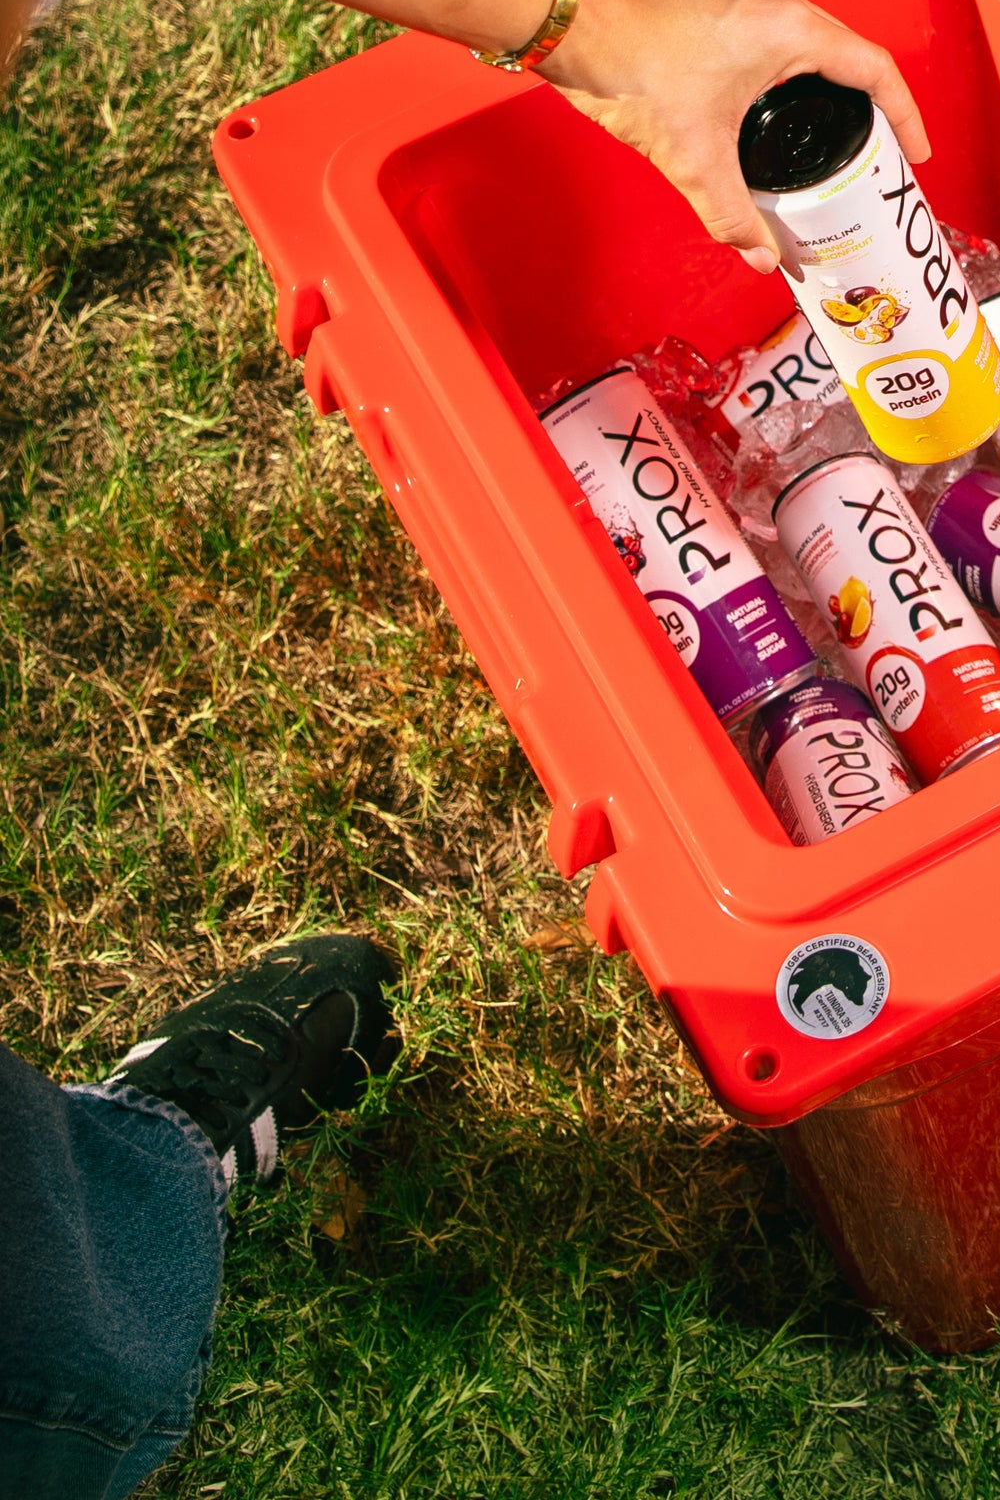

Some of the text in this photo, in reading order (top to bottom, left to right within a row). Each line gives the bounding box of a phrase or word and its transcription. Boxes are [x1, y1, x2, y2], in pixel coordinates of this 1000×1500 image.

[796, 223, 862, 248] SPARKLING
[813, 238, 855, 255] MANGO
[881, 153, 969, 340] PROX
[738, 332, 833, 418] PRO
[875, 367, 936, 395] 20g
[888, 388, 942, 411] protein
[643, 408, 712, 508] HYBRID ENERGY
[602, 412, 732, 586] PROX
[842, 488, 963, 643] PROX
[726, 596, 766, 623] NATURAL
[733, 605, 768, 631] ENERGY
[754, 631, 779, 651] ZERO
[756, 637, 788, 662] SUGAR
[874, 666, 912, 707] 20g
[952, 658, 995, 677] NATURAL
[960, 666, 996, 683] ENERGY
[891, 688, 920, 726] protein
[807, 730, 885, 827] PROX
[804, 773, 838, 836] HYBRID ENERGY
[785, 938, 885, 1016] IGBC CERTIFIED BEAR RESISTANT
[815, 994, 843, 1034] Certification
[824, 990, 853, 1028] TUNDRA 35
